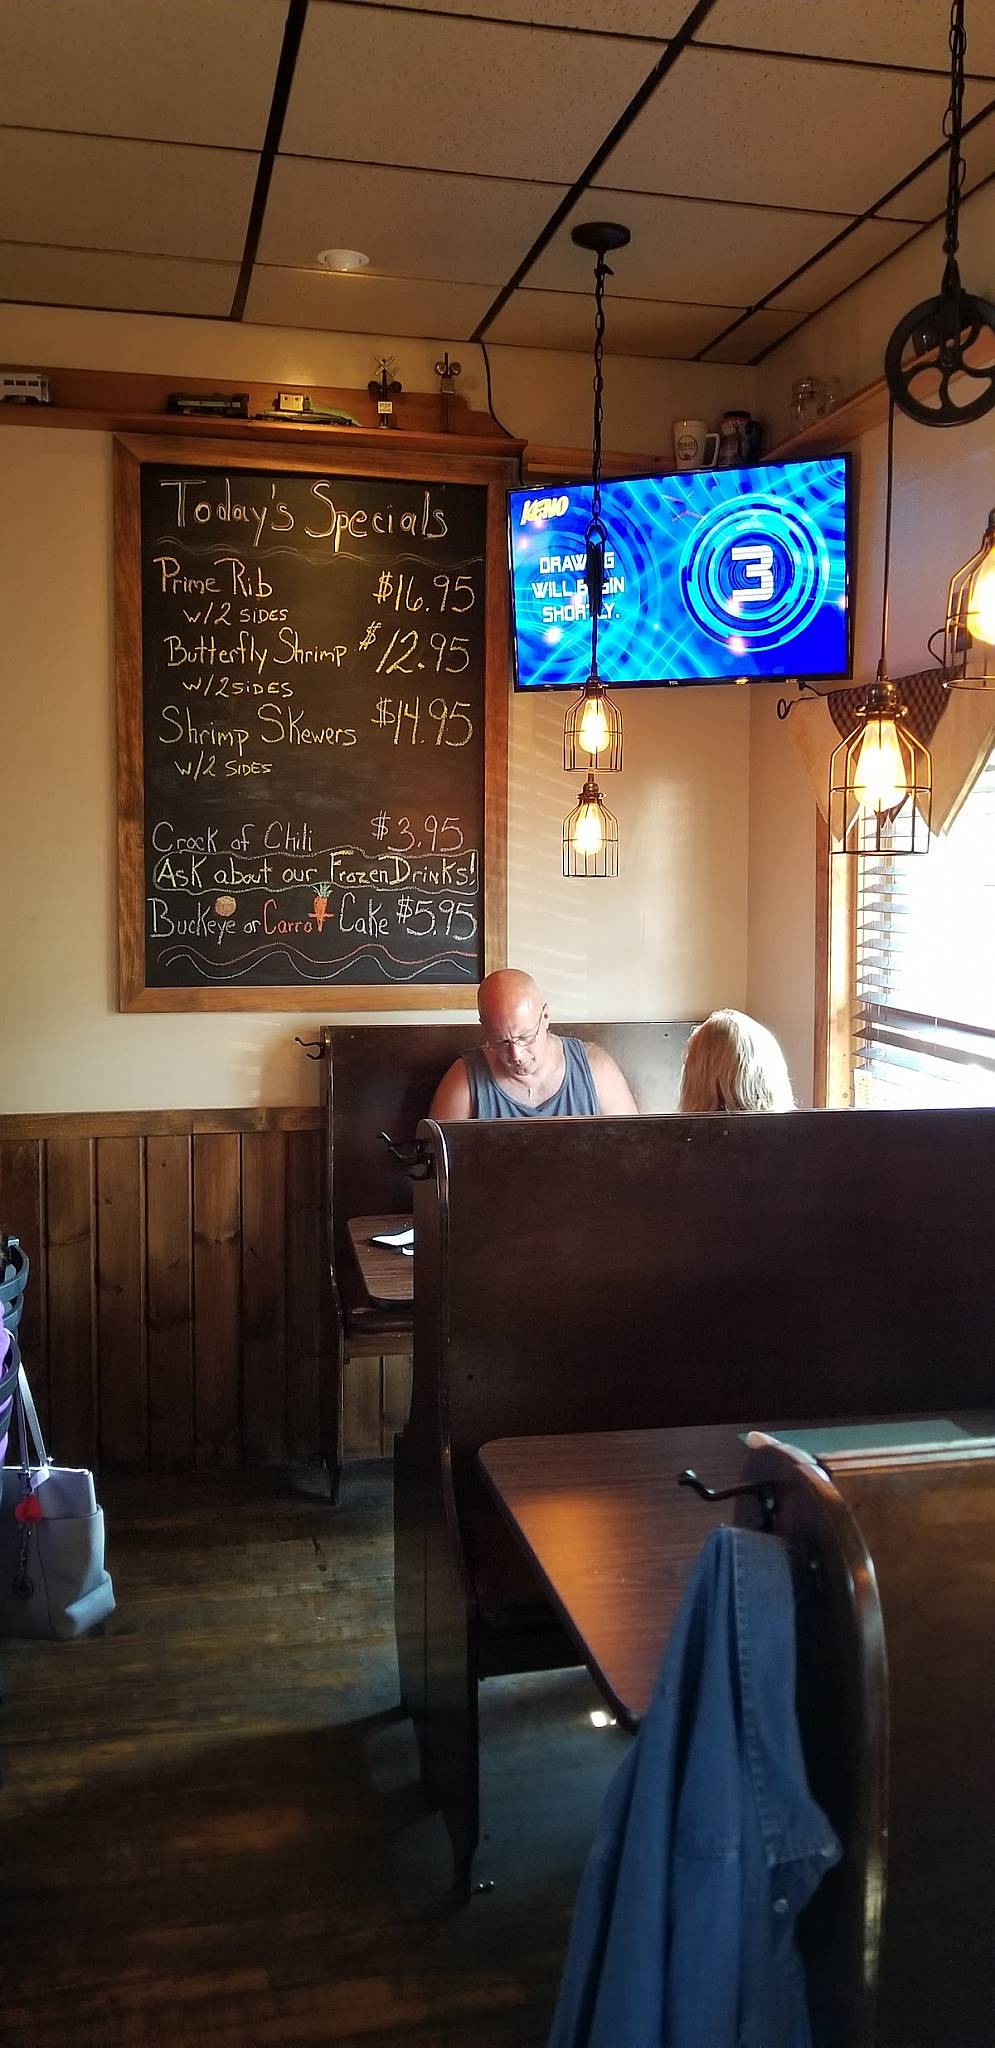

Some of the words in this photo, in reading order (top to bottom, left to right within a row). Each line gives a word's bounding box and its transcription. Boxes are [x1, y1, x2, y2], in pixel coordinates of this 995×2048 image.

[160, 478, 294, 546] Today's
[304, 480, 449, 552] Specials
[153, 556, 222, 595] Prime
[214, 557, 273, 598] Rib
[372, 571, 476, 613] $16.95
[531, 580, 573, 599] WILL
[539, 552, 615, 574] DRAWG
[731, 545, 774, 602] 3
[163, 631, 268, 674] Butterfly
[273, 626, 347, 667] Shrimp
[358, 621, 470, 674] $12.95
[158, 705, 250, 757] Shrimp
[371, 697, 474, 747] $14.95
[230, 823, 255, 851] of
[263, 821, 313, 852] Chili
[370, 810, 464, 853] $3.95
[213, 860, 273, 885] about
[281, 868, 318, 883] our
[329, 851, 389, 884] Frozen
[148, 897, 237, 946] Buckeye
[243, 919, 262, 934] or
[262, 898, 334, 934] Carrot
[339, 892, 389, 938] Cake
[397, 894, 478, 940] $5.95
